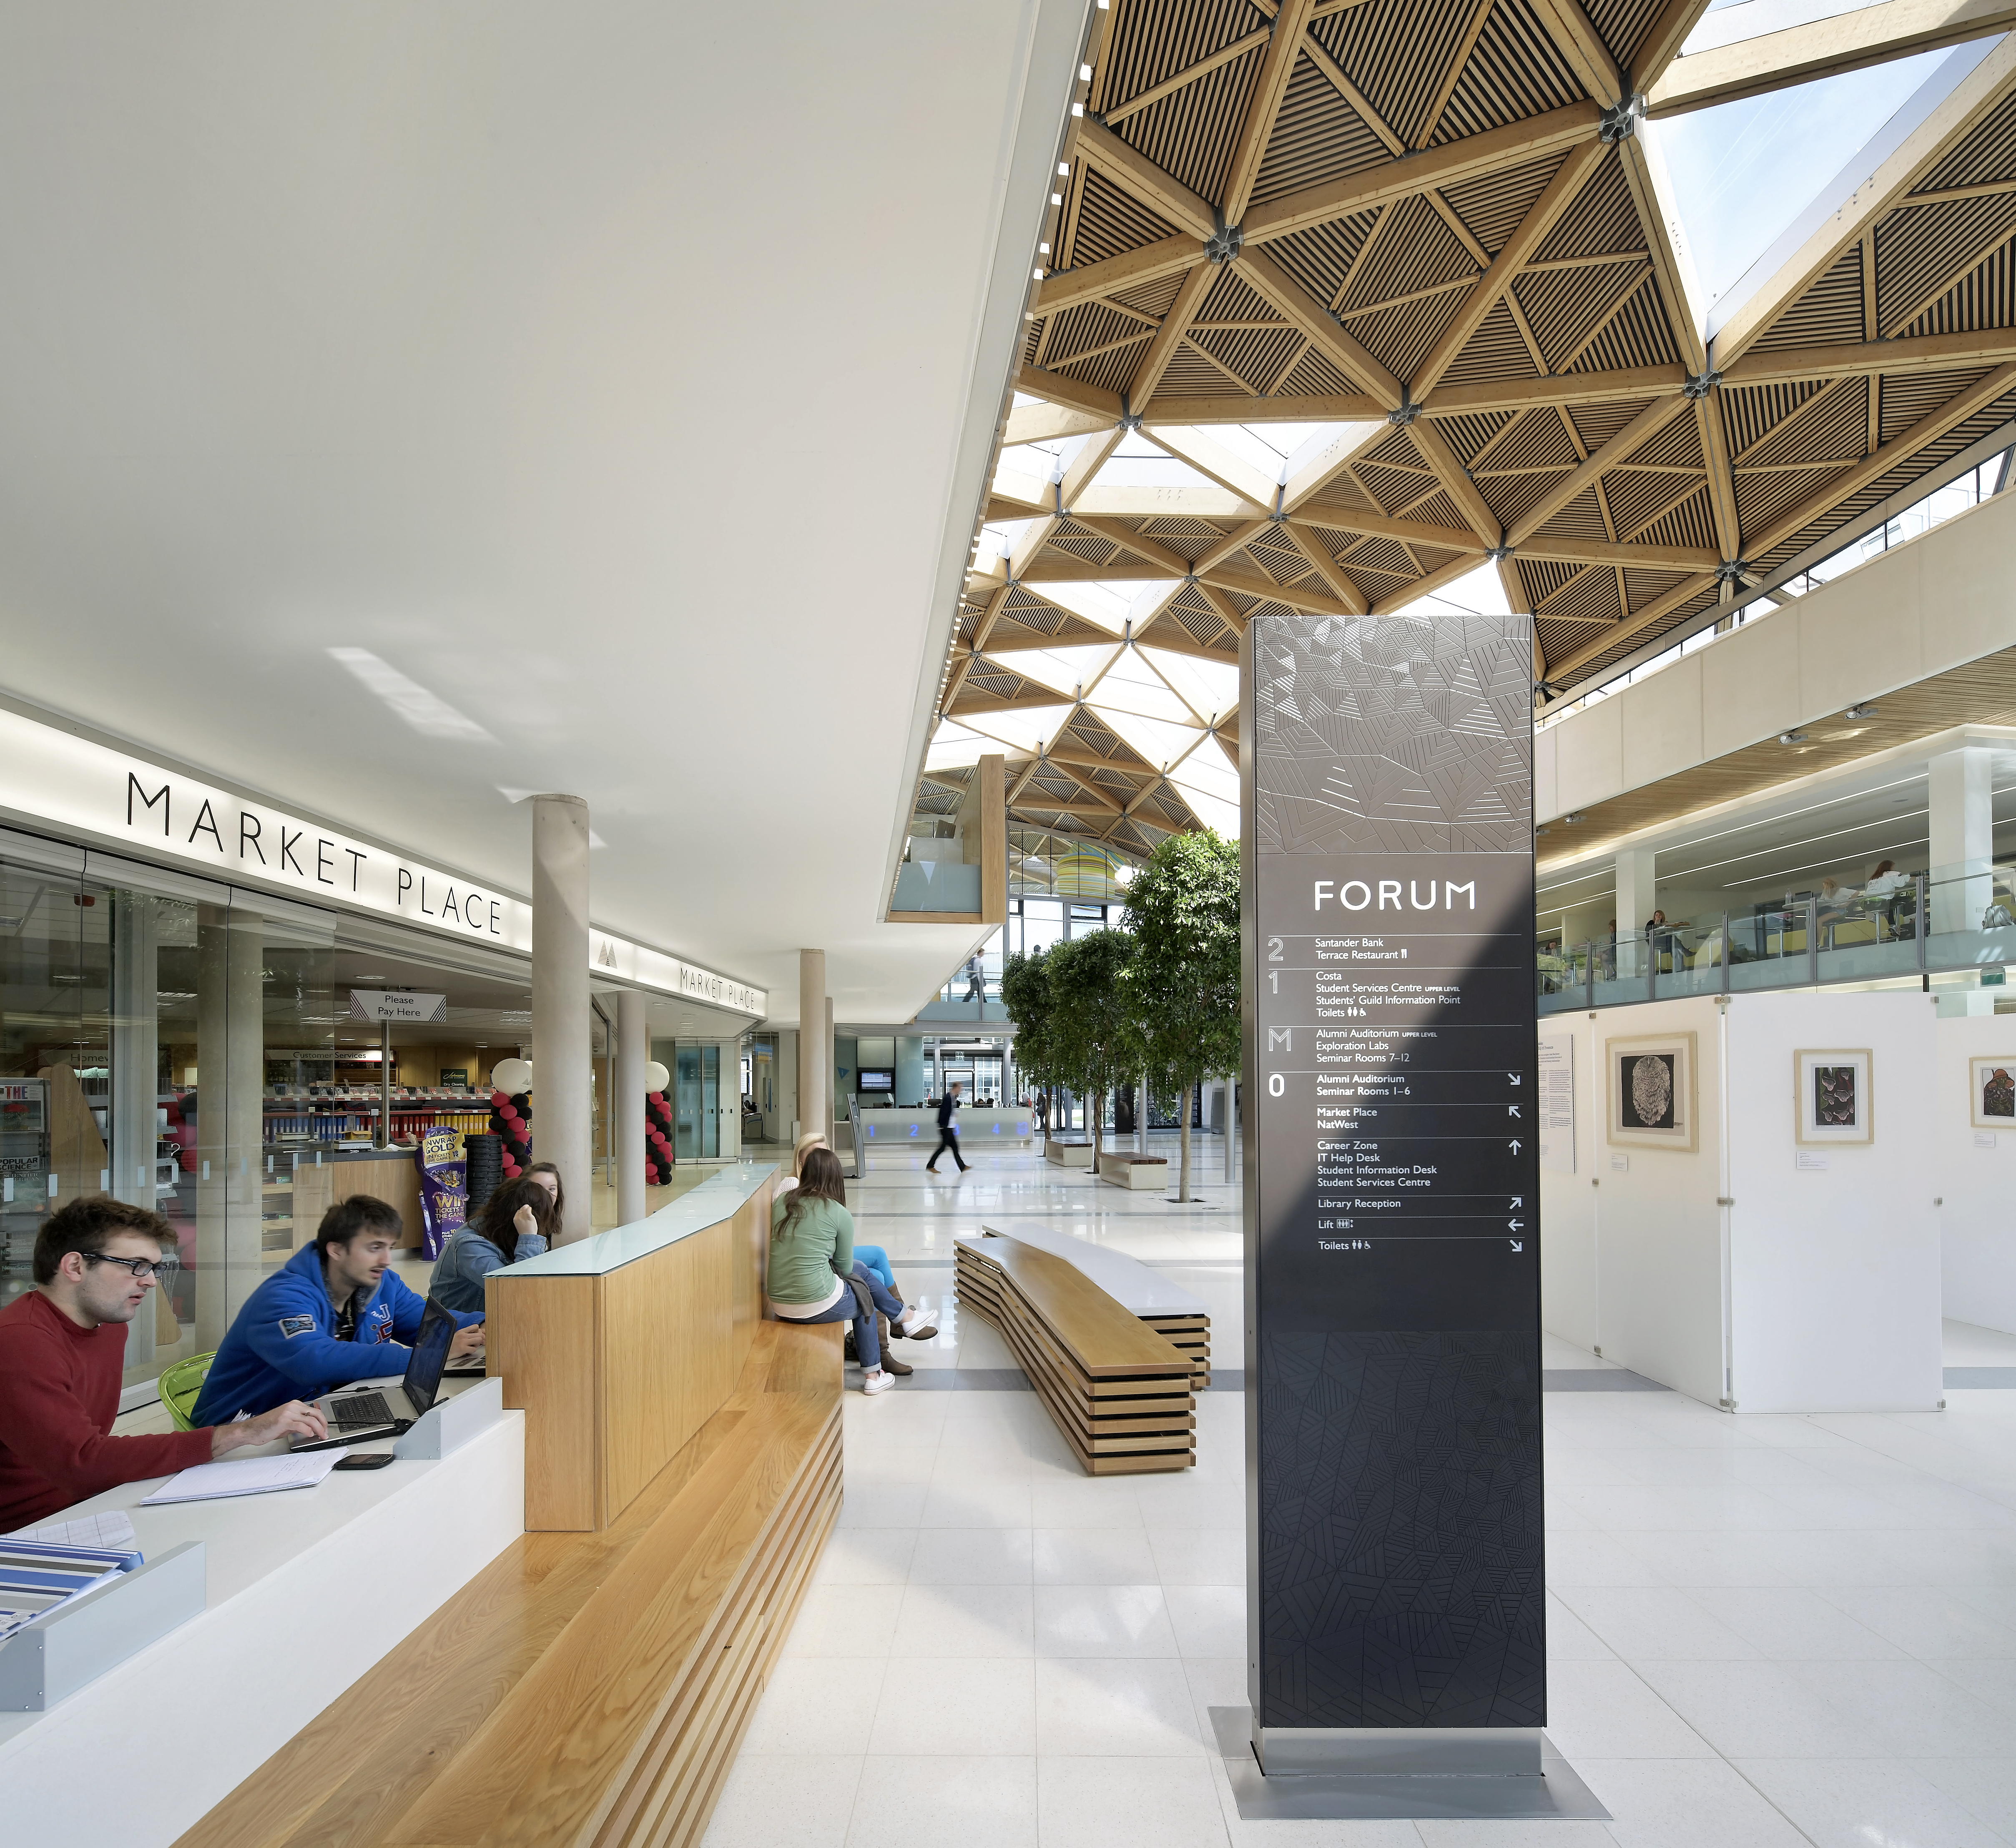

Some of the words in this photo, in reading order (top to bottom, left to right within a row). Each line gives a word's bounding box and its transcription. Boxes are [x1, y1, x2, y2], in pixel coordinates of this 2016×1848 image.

[128, 772, 367, 892] MARKET
[398, 867, 500, 935] PLACE
[1315, 880, 1475, 910] FORUM
[1315, 938, 1360, 947] Santander
[1362, 938, 1384, 947] Bank
[1268, 938, 1283, 961] 2
[1316, 950, 1349, 960] Terrace
[1352, 950, 1399, 959] Restaurant
[1316, 971, 1342, 981] Costa
[1268, 971, 1278, 994] 1
[680, 967, 723, 999] MARKET
[729, 985, 754, 1009] PLACE
[1316, 983, 1350, 993] Student
[1352, 983, 1388, 992] Services
[1391, 983, 1422, 992] Centre
[385, 995, 414, 1004] Please
[1316, 996, 1356, 1005] Students'
[1358, 995, 1382, 1005] Guild
[1386, 995, 1436, 1004] Information
[1439, 995, 1461, 1004] Point
[378, 1007, 394, 1017] Pay
[397, 1008, 421, 1016] Here
[1316, 1008, 1345, 1017] Toilets
[1316, 1029, 1347, 1038] Alumni
[1349, 1028, 1399, 1038] Auditorium
[1268, 1028, 1291, 1051] M
[1316, 1041, 1366, 1052] Exploration
[1369, 1041, 1389, 1050] Labs
[1316, 1053, 1353, 1063] Seminar
[1356, 1053, 1386, 1062] Rooms
[1316, 1074, 1350, 1083] Alumni
[1352, 1074, 1405, 1083] Auditorium
[1269, 1074, 1285, 1097] 0
[5, 1086, 28, 1100] THE
[1317, 1086, 1355, 1096] Seminar
[1358, 1086, 1389, 1095] Rooms
[1317, 1107, 1351, 1116] Market
[1353, 1107, 1378, 1116] Place
[992, 1123, 1000, 1134] 4
[1317, 1120, 1358, 1129] NatWest
[869, 1125, 874, 1137] 1
[910, 1124, 918, 1136] 2
[426, 1143, 455, 1154] GOLD
[1317, 1141, 1351, 1150] Career
[1353, 1141, 1378, 1149] Zone
[1318, 1153, 1328, 1162] IT
[1331, 1153, 1353, 1164] Help
[1356, 1153, 1380, 1162] Desk
[1318, 1165, 1353, 1174] Student
[1356, 1165, 1410, 1174] Information
[1413, 1165, 1437, 1174] Desk
[1318, 1178, 1354, 1187] Student
[1356, 1178, 1395, 1187] Services
[1398, 1177, 1431, 1186] Centre
[1318, 1199, 1352, 1210] Library
[1355, 1199, 1401, 1210] Reception
[1318, 1220, 1334, 1229] Lift
[1318, 1241, 1349, 1250] Toilets
